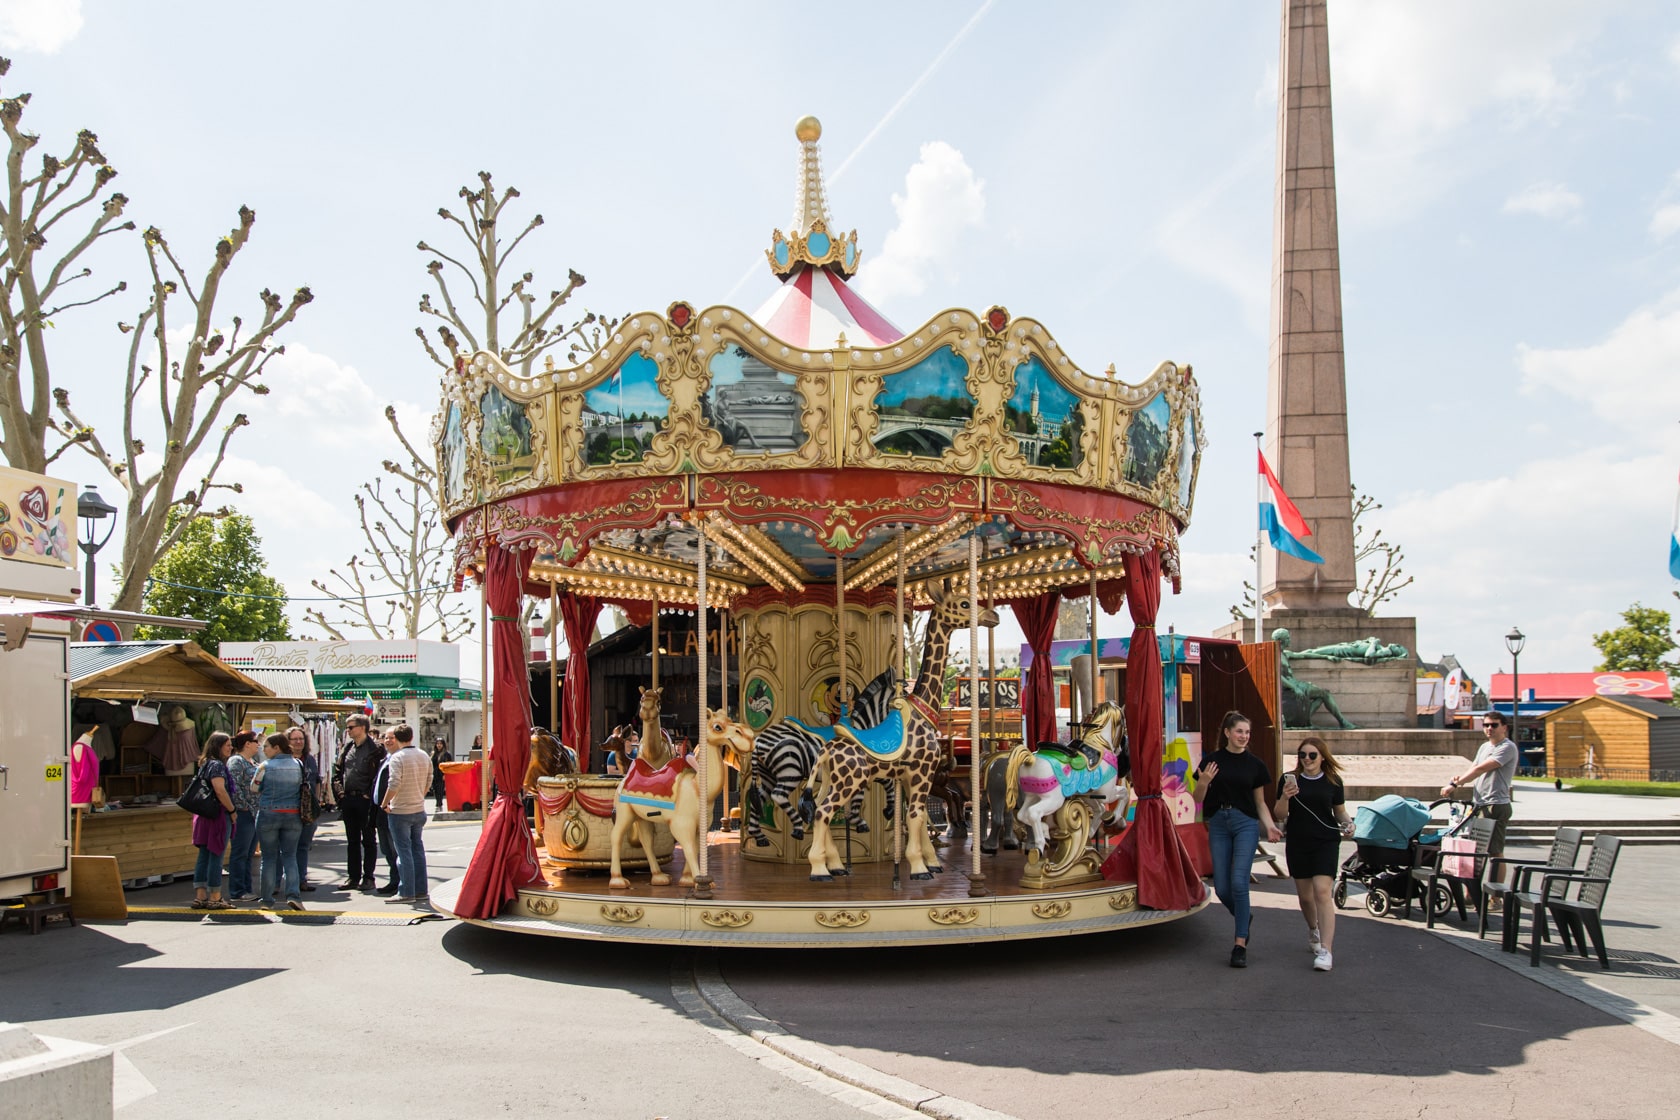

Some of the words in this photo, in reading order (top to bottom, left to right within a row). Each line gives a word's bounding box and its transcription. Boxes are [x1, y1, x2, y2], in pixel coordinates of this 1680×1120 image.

[658, 629, 736, 656] LAMM
[253, 643, 309, 666] Pasta
[315, 641, 381, 673] Fresca
[960, 680, 1018, 700] KRÖS
[46, 768, 61, 777] G24
